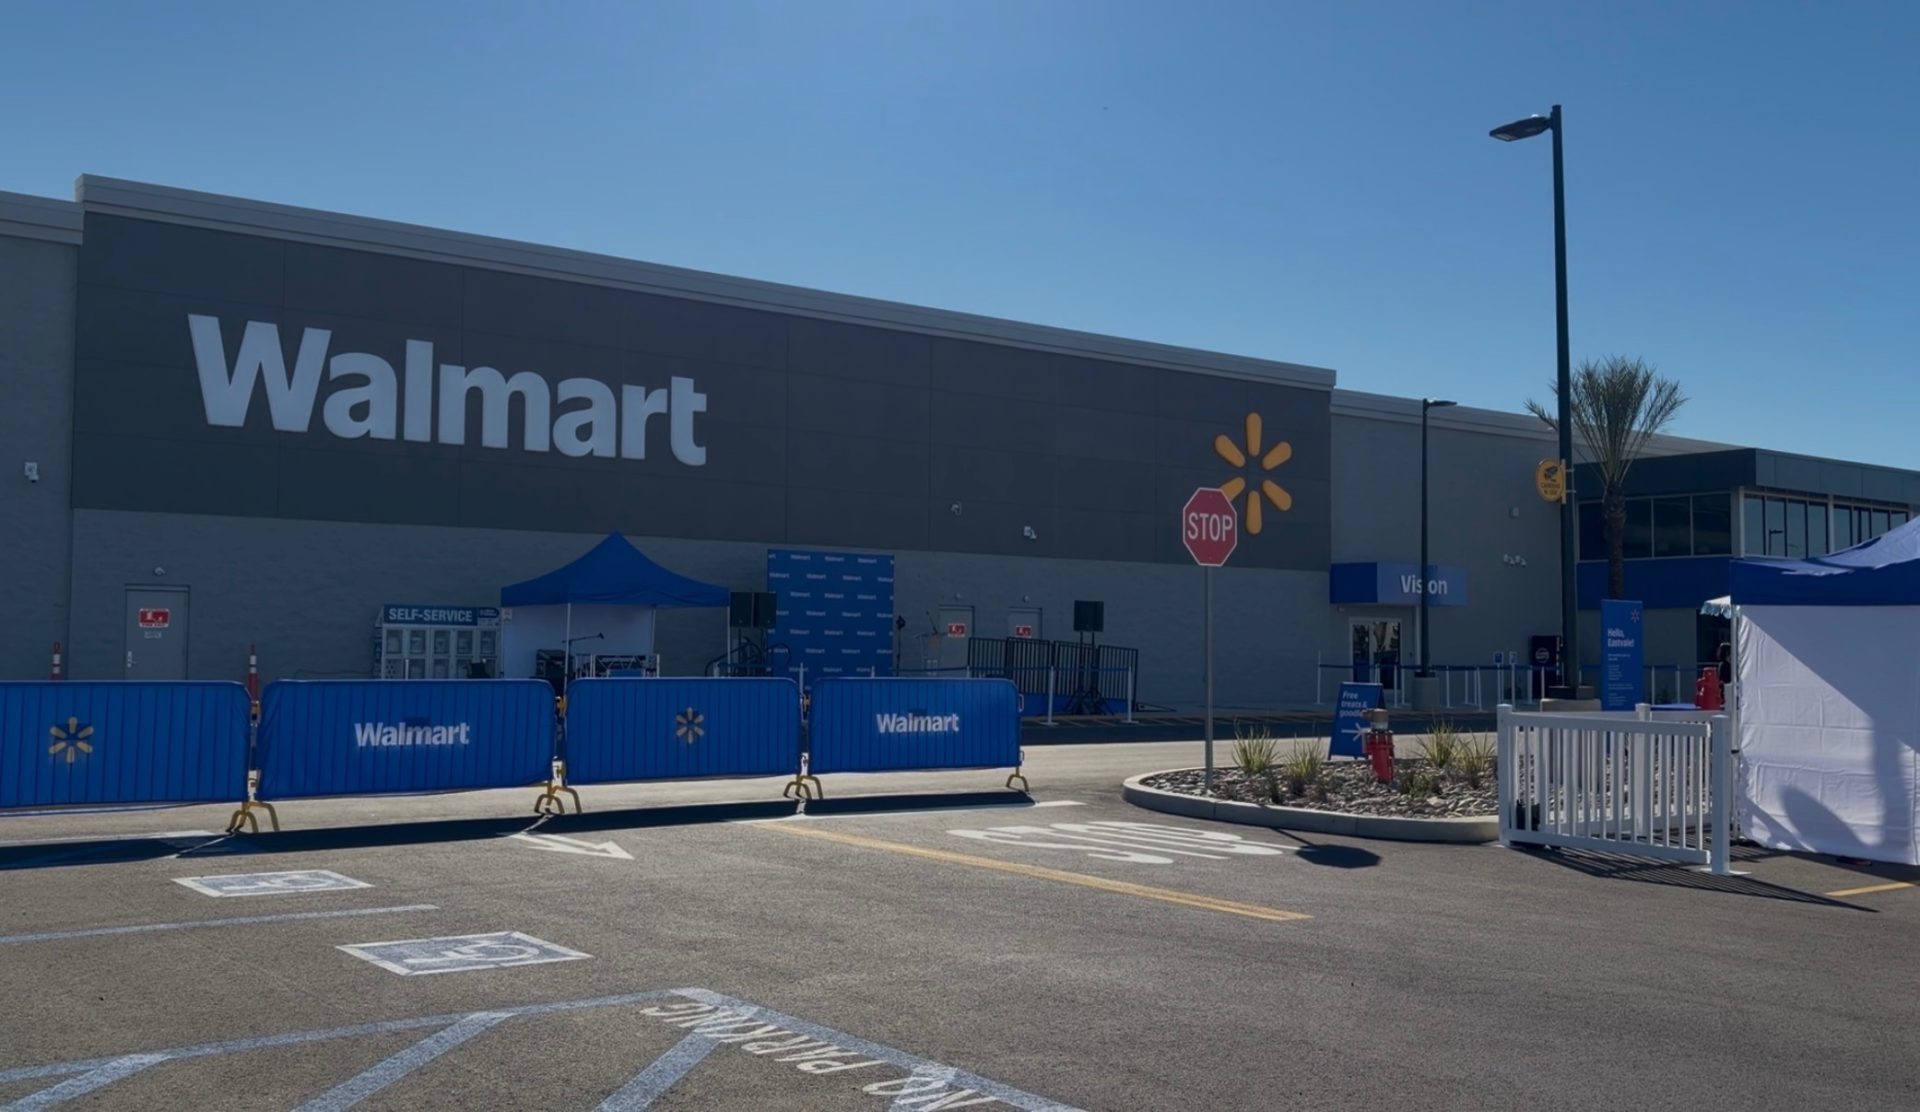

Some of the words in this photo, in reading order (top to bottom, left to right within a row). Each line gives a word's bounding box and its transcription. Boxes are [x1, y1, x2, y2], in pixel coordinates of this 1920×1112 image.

[188, 313, 707, 466] Walmart
[1187, 511, 1233, 542] STOP
[1400, 574, 1448, 595] Vison
[388, 607, 473, 622] SELF-SERVICE
[1607, 628, 1625, 638] Hello,
[1342, 691, 1359, 699] Free
[876, 713, 960, 733] Walmart
[354, 722, 470, 747] Walmart
[640, 1003, 890, 1075] PARKING
